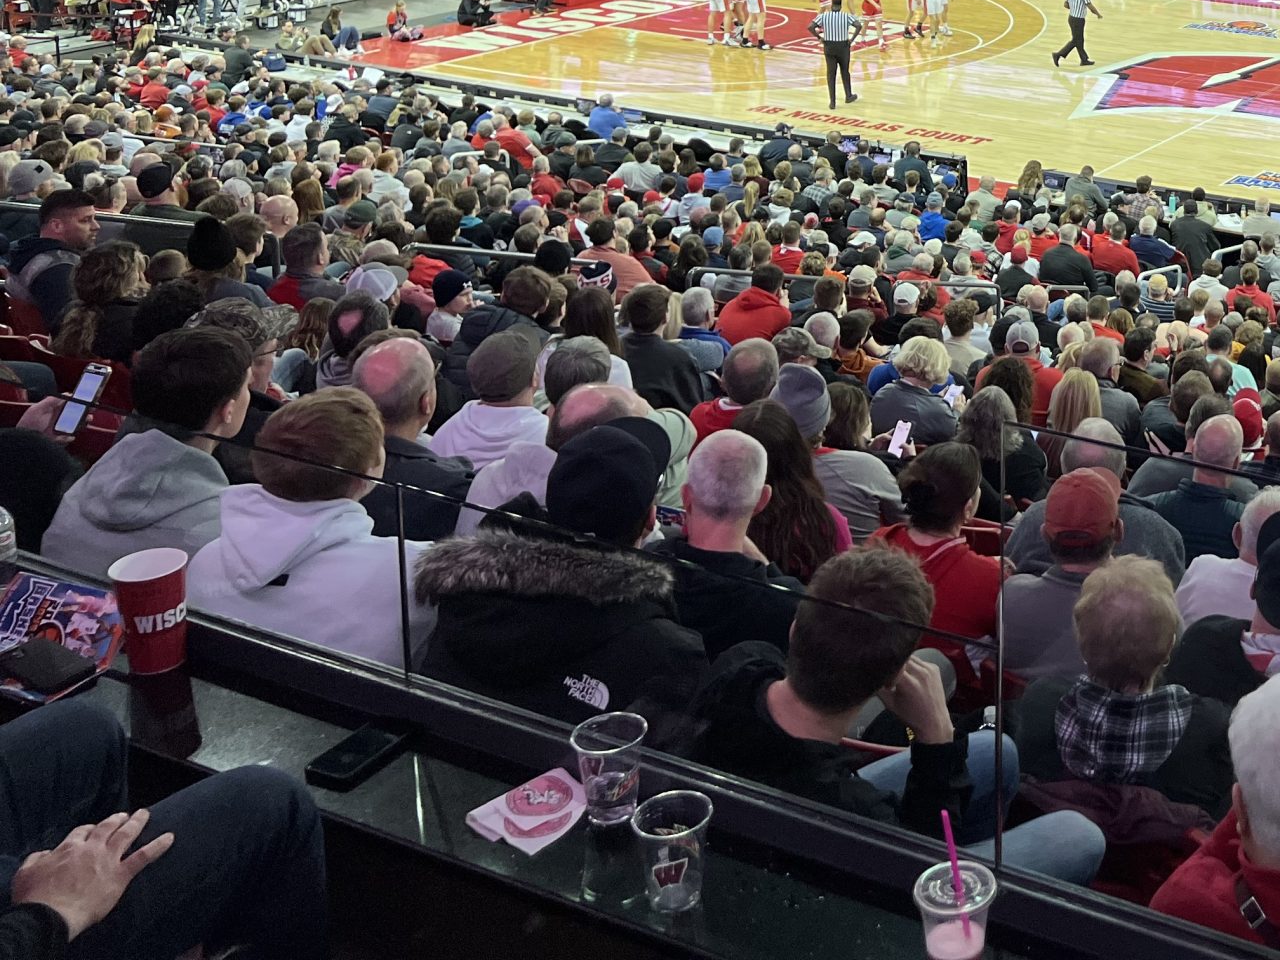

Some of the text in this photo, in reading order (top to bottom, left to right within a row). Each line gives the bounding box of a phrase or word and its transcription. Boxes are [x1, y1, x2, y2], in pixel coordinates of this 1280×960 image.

[747, 105, 993, 145] AB NICHOLAS COURT
[563, 676, 596, 696] NORTH
[582, 673, 600, 687] THE
[568, 687, 592, 703] FACE
